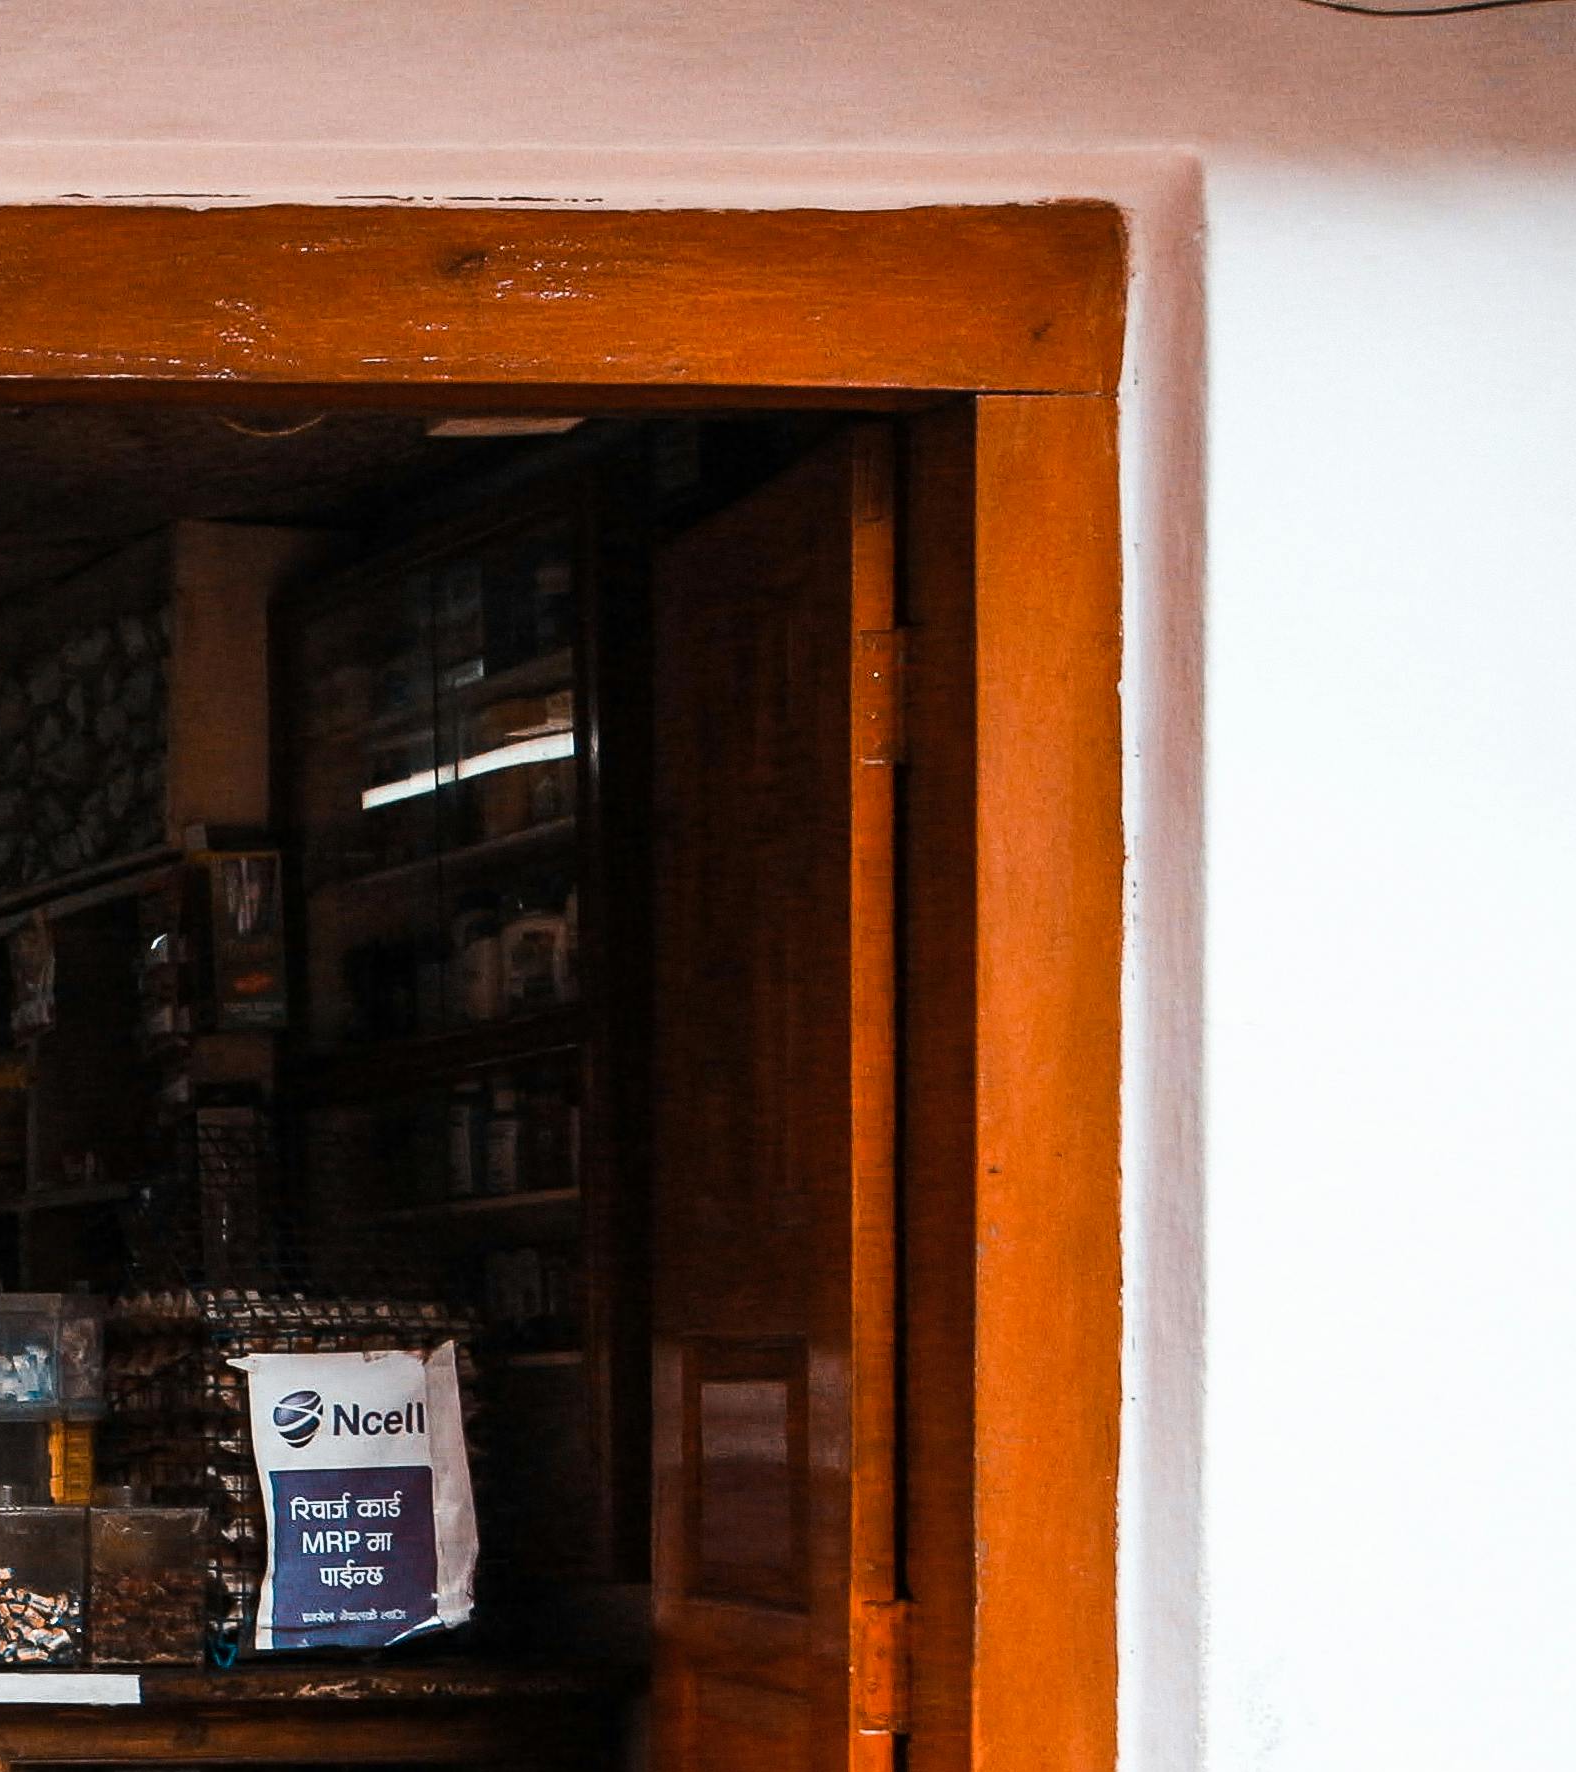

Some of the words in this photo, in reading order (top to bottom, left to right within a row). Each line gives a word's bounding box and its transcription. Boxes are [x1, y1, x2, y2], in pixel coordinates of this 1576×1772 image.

[333, 1402, 426, 1436] Ncell
[290, 1492, 351, 1520] रिचार्ज
[356, 1491, 403, 1519] कार्ड
[302, 1531, 361, 1553] MRP
[366, 1532, 393, 1552] मा
